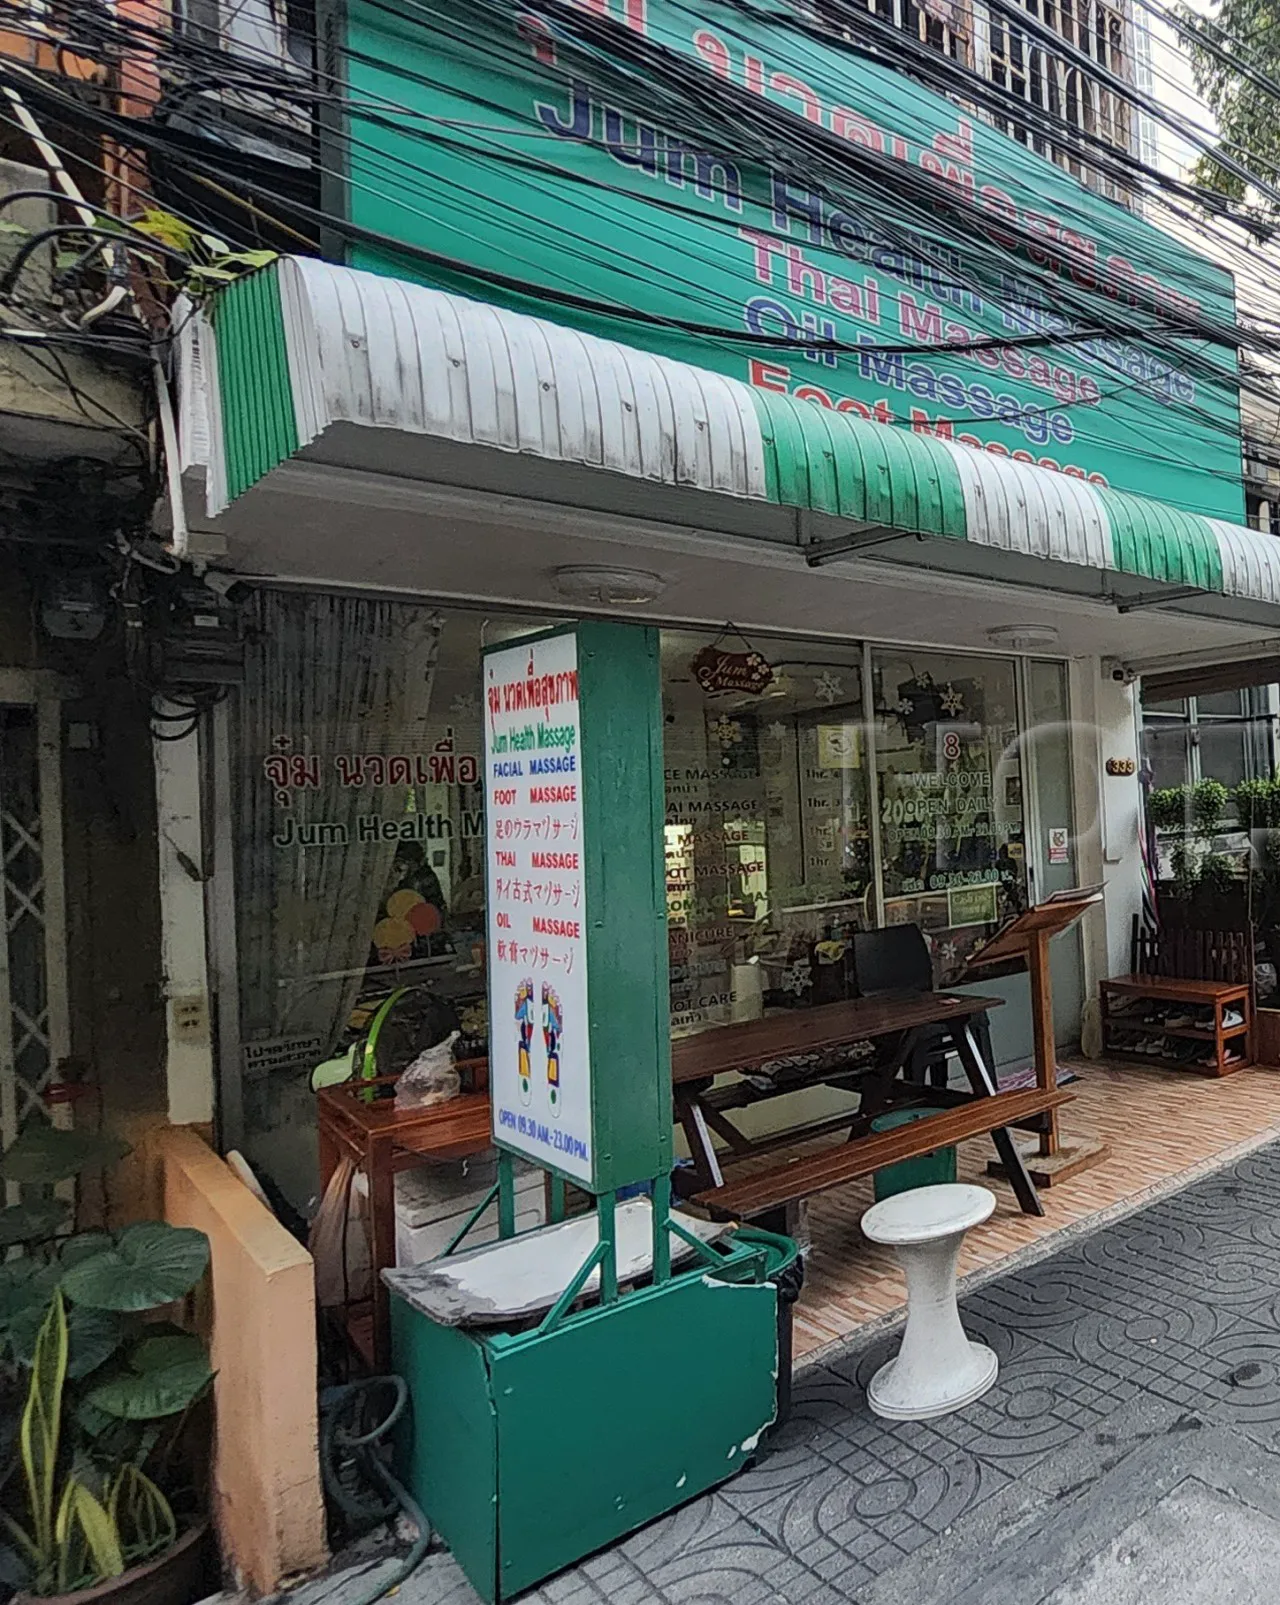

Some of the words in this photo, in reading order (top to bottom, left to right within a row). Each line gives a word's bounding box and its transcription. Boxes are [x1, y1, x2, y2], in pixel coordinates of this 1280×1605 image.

[533, 77, 743, 216] Jum
[738, 224, 882, 326] Thai
[898, 289, 1101, 406] Massage
[744, 295, 839, 370] Oil
[856, 330, 1075, 446] Massage
[697, 654, 747, 681] Jum
[491, 733, 508, 755] Jum
[509, 726, 536, 753] Health
[537, 721, 576, 754] Massage
[943, 731, 961, 760] 8
[264, 735, 321, 808] จุ๋ม
[493, 760, 524, 779] FACIAL
[529, 755, 577, 776] MASSAGE
[1112, 759, 1134, 774] 333
[913, 772, 992, 789] WELCOME
[494, 788, 517, 806] FOOT
[529, 785, 578, 804] MASSAGE
[688, 799, 757, 813] MASSAGE
[904, 800, 950, 815] OPEN
[955, 796, 997, 813] DAILY
[273, 817, 349, 847] Jum
[357, 812, 455, 842] Health
[677, 830, 749, 845] MASSAGE
[495, 850, 517, 868] THAI
[531, 851, 580, 870] MASSAGE
[694, 861, 765, 876] MASSAGE
[496, 911, 512, 929] OIL
[532, 915, 580, 939] MASSAGE
[698, 990, 738, 1008] CARE
[499, 1107, 517, 1130] OPEN
[517, 1113, 537, 1140] 09.30
